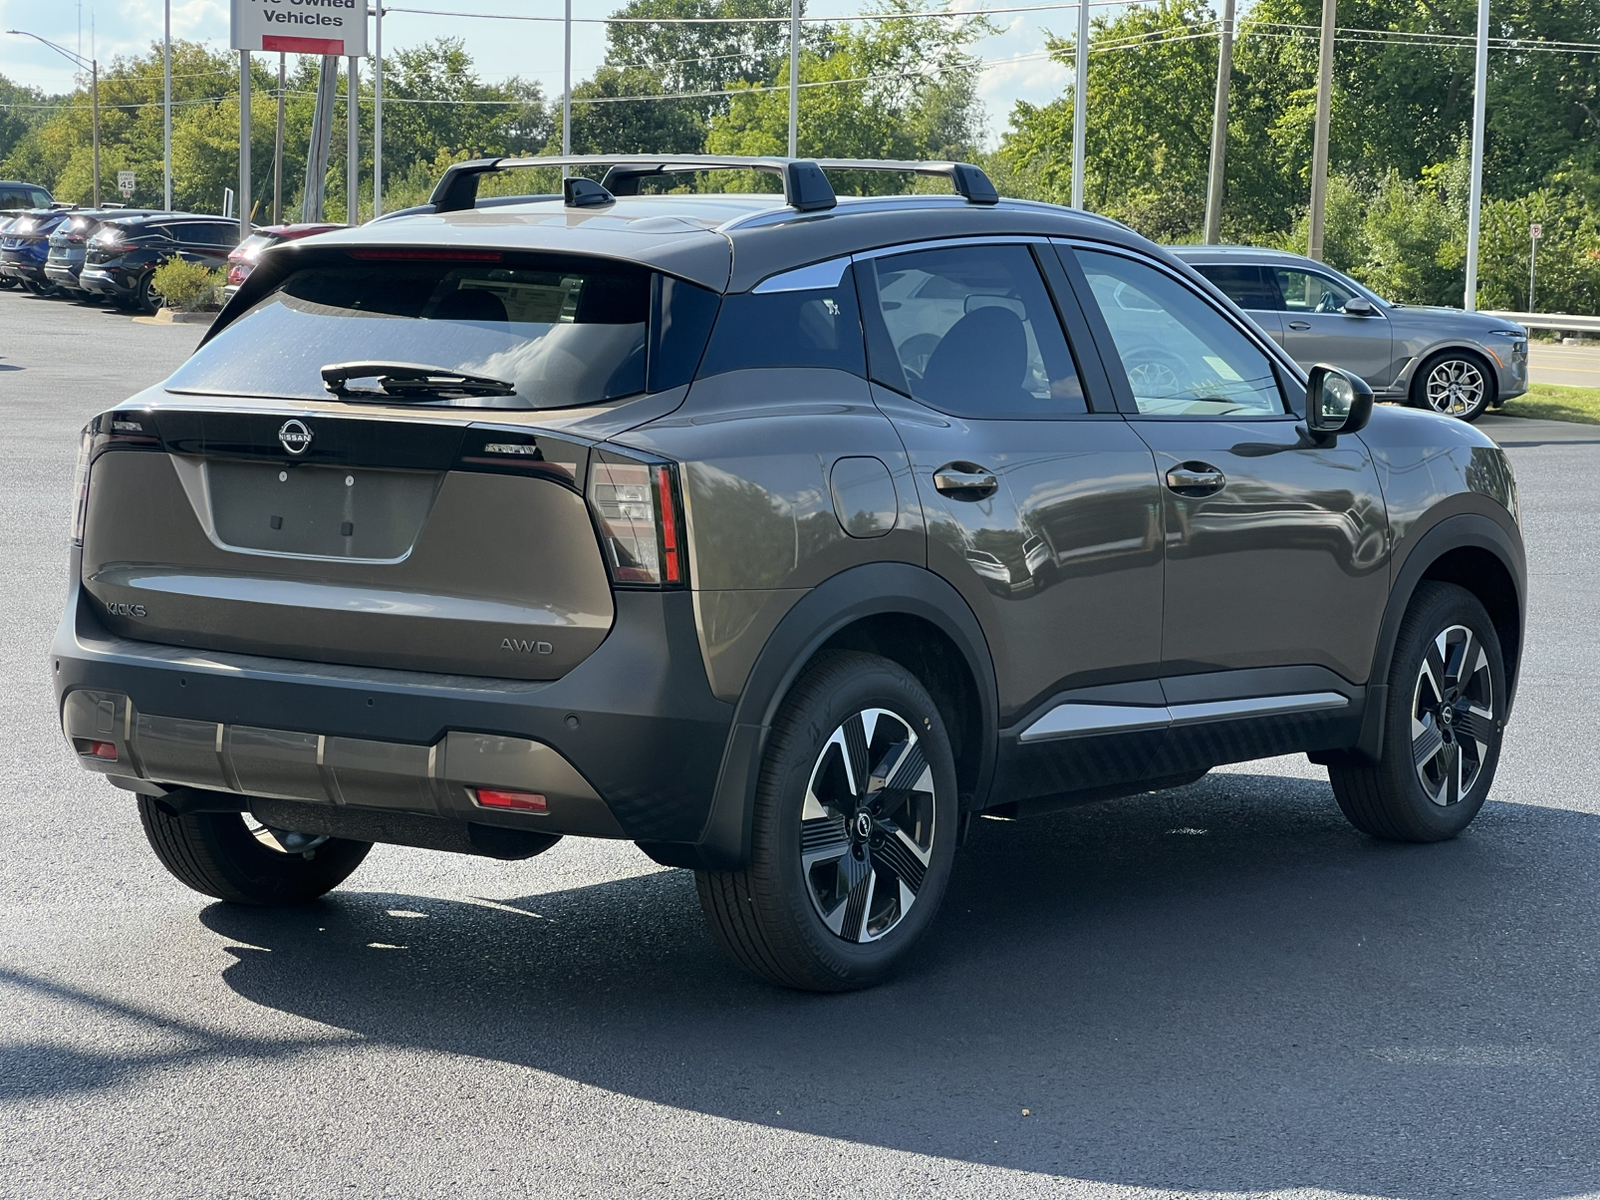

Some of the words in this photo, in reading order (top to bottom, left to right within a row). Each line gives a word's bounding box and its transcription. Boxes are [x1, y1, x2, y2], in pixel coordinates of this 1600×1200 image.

[263, 9, 343, 26] Vehicles
[120, 181, 133, 189] 45
[106, 602, 147, 617] KICKS
[500, 638, 554, 655] AWD
